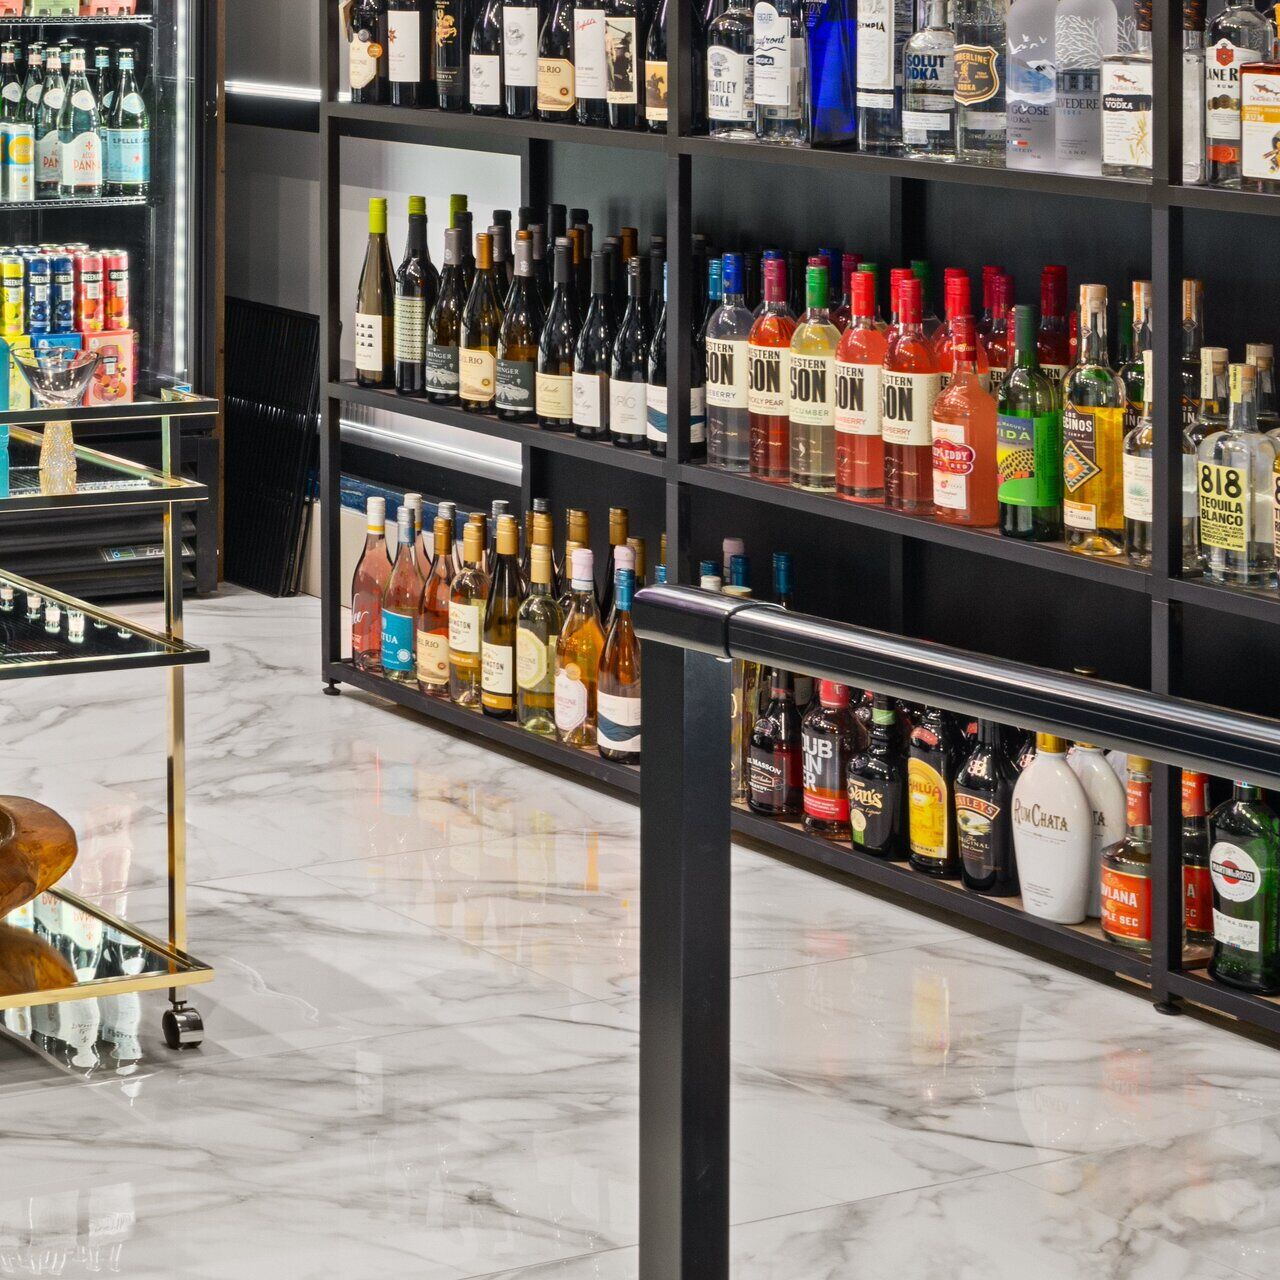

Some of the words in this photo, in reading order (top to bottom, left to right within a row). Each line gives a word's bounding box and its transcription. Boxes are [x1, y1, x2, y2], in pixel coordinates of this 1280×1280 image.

[906, 54, 946, 68] SOLUT
[546, 65, 561, 74] RIO
[906, 68, 939, 81] ODKA
[1104, 100, 1133, 110] VODKA
[43, 156, 59, 167] PAN
[707, 341, 734, 353] ESTERN
[749, 348, 780, 360] ESTERN
[468, 357, 483, 365] RIO
[836, 365, 864, 377] STERN
[790, 366, 826, 403] SON
[883, 374, 913, 387] STERN
[1065, 411, 1077, 419] LOS
[999, 430, 1031, 441] IDA
[945, 450, 968, 460] EDDY
[1201, 464, 1242, 499] 818
[1201, 495, 1244, 515] TEQUILA
[1201, 508, 1244, 527] BLANCO
[382, 632, 399, 644] TUA
[425, 639, 439, 649] RIO
[752, 758, 782, 775] MASSON
[1119, 915, 1139, 927] SEC
